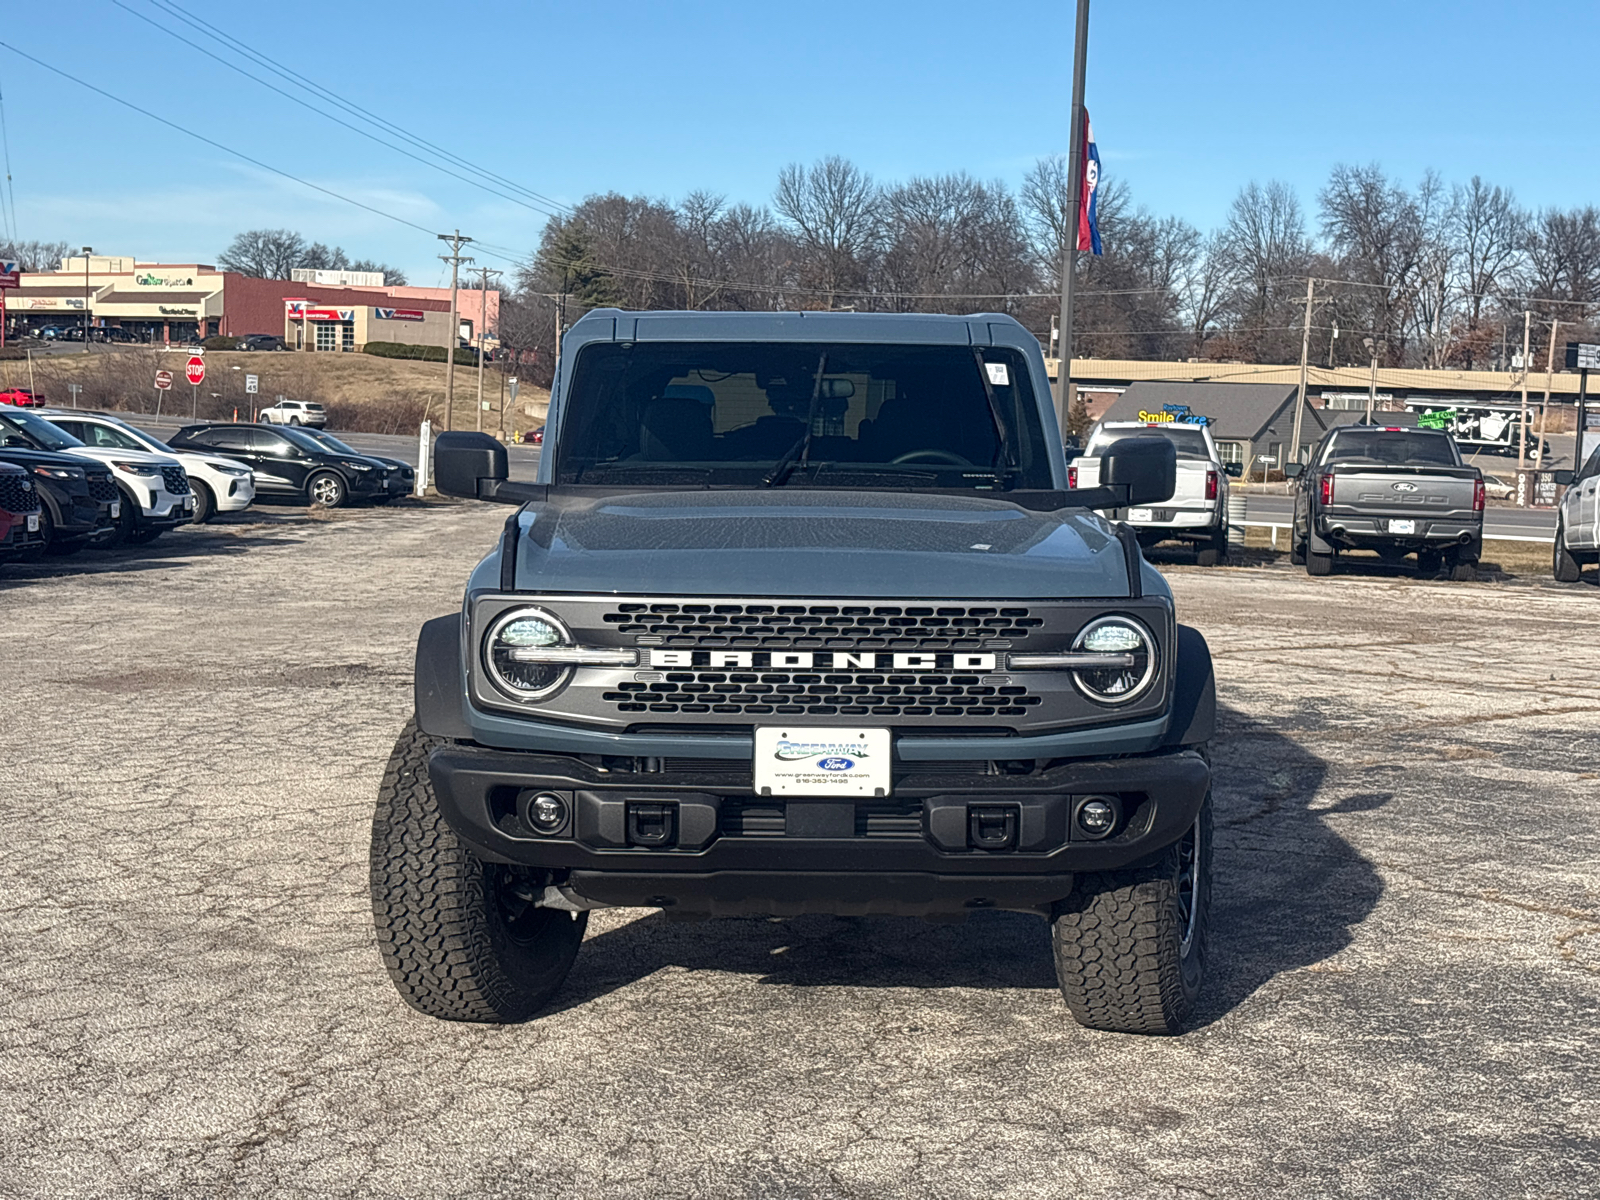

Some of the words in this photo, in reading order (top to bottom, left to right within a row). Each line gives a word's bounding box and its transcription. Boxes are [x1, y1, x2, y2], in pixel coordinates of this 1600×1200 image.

[187, 364, 204, 376] STOP
[1138, 410, 1175, 423] Smile
[1175, 411, 1207, 425] Care
[1438, 411, 1455, 419] COW
[1358, 493, 1449, 505] F-150
[650, 650, 997, 670] BRONCO
[776, 741, 868, 755] GREENWAY
[823, 758, 848, 770] Ford
